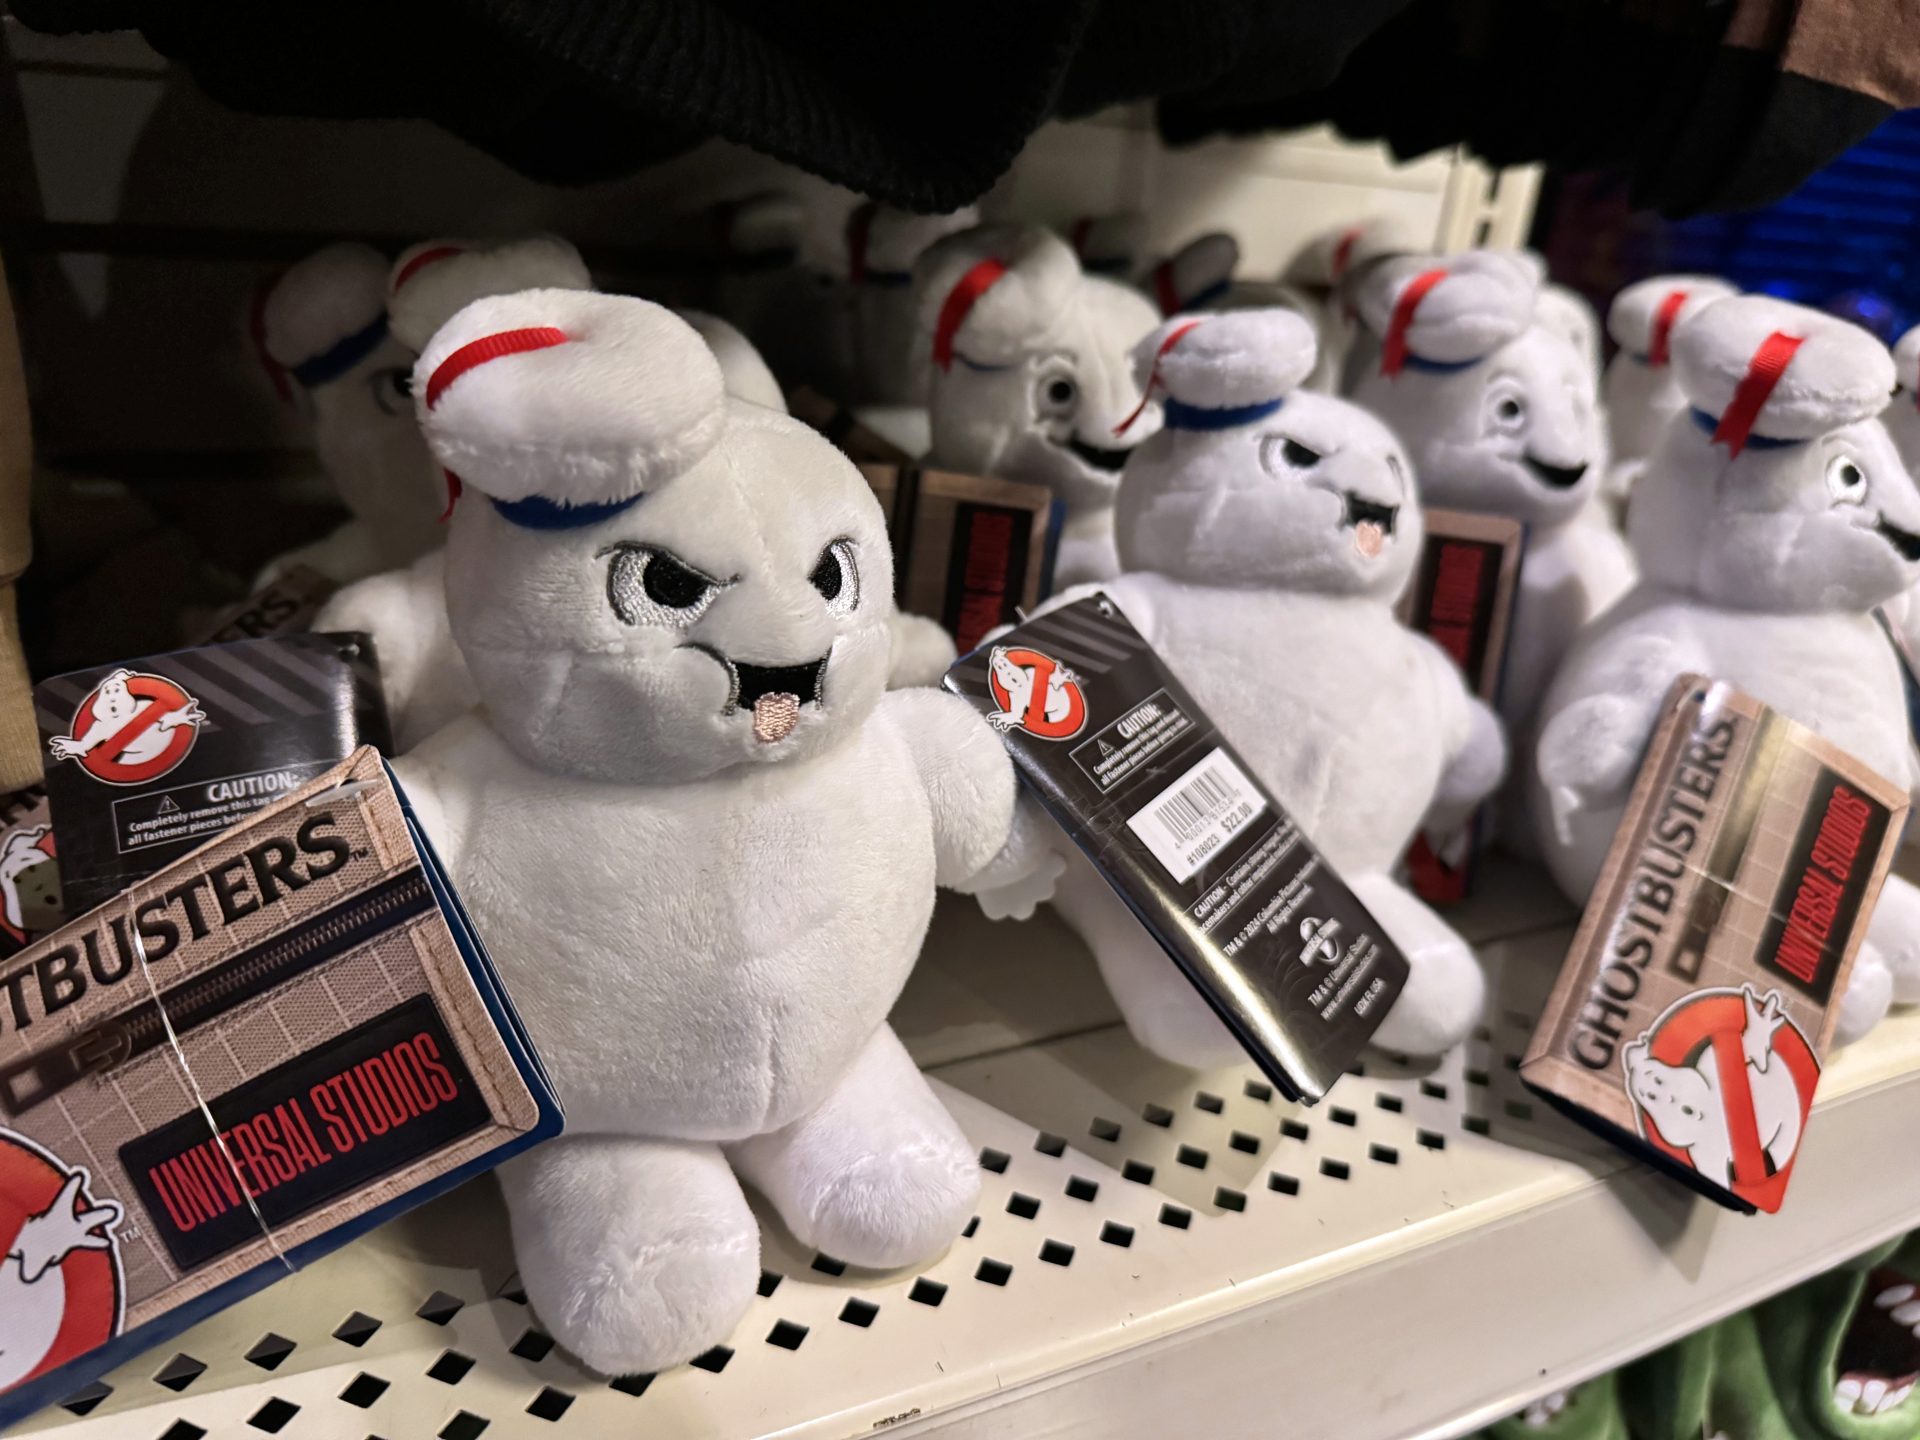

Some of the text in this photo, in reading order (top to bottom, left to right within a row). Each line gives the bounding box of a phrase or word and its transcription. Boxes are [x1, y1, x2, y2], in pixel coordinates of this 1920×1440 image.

[1117, 703, 1162, 739] CAUTION:
[208, 771, 300, 802] CAUTION:
[128, 834, 142, 846] all
[144, 825, 188, 842] fastener
[190, 819, 222, 833] pieces
[129, 812, 188, 832] Completely
[190, 804, 229, 819] remove
[231, 799, 251, 811] this
[1186, 833, 1221, 867] #108023
[1220, 801, 1253, 834] $22.00
[1226, 890, 1241, 905] and
[1572, 716, 1736, 1070] GHOSTBUSTERS
[1775, 785, 1871, 984] UNIVERSAL STUDIOS
[1194, 886, 1225, 918] CAUTION
[0, 812, 350, 1032] TBUSTERS
[1224, 941, 1238, 957] TM
[149, 1031, 458, 1233] UNIVERSAL STUDIOS
